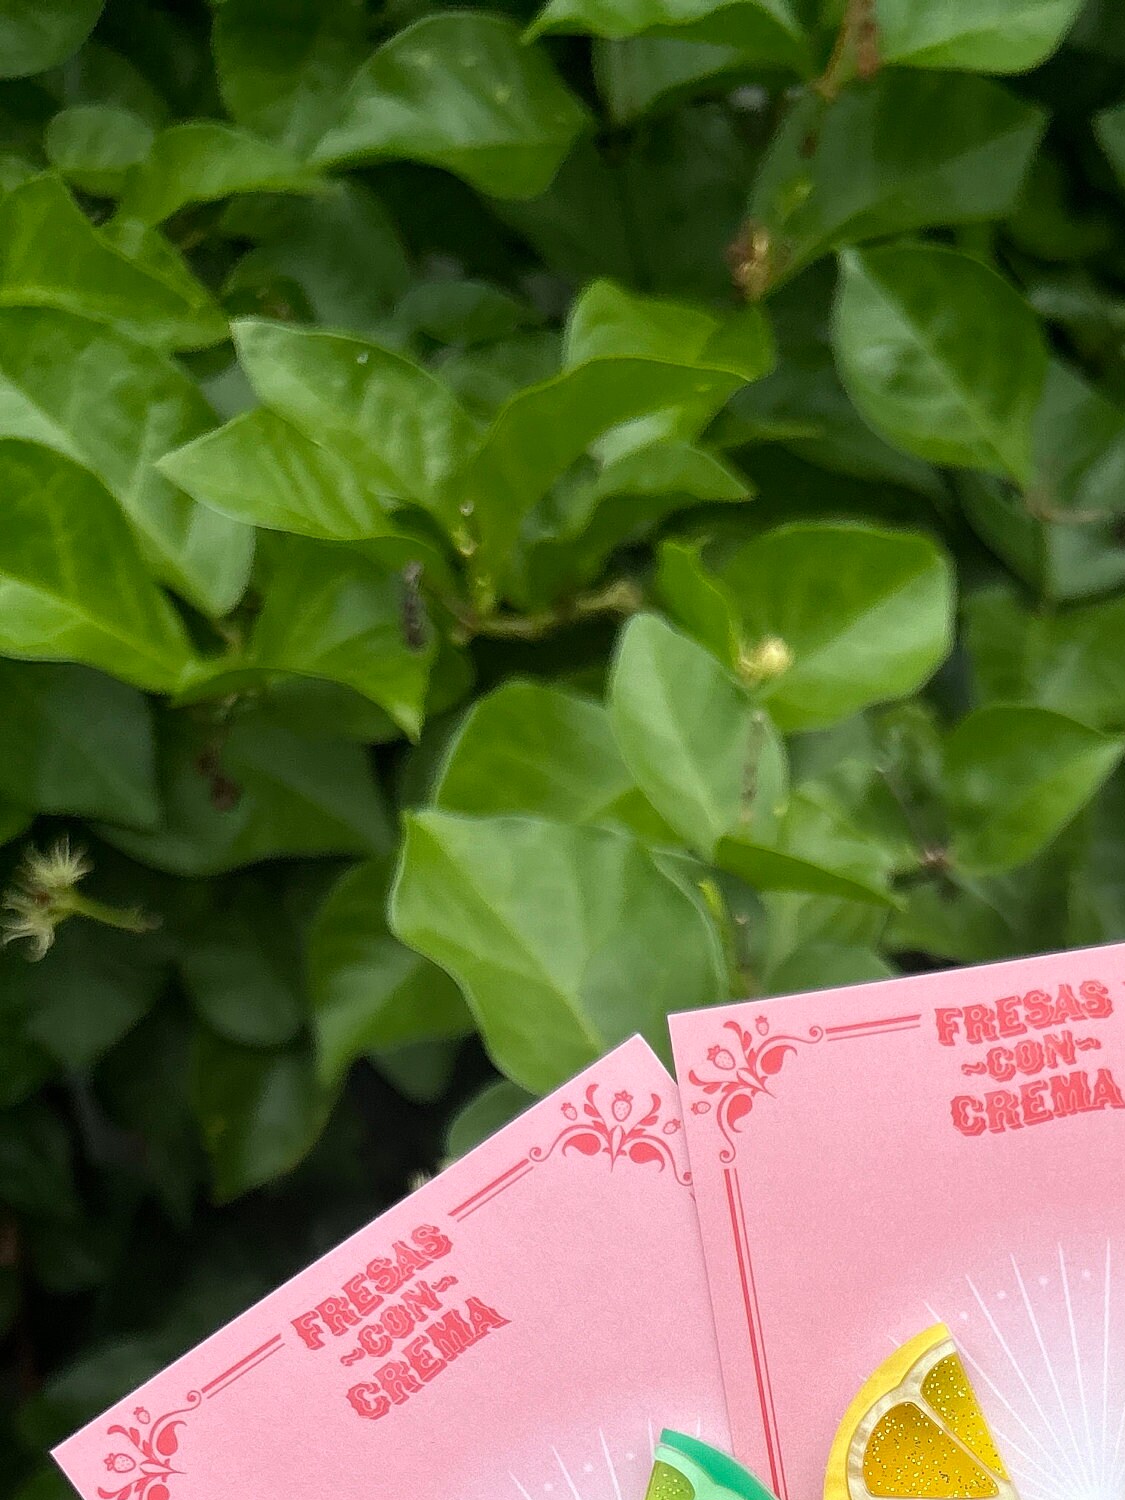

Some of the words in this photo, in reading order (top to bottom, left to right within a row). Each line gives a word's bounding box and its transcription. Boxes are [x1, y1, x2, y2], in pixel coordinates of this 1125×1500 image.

[934, 980, 1113, 1046] FRESAS
[290, 1224, 453, 1350] FRESAS
[346, 1297, 512, 1420] CREMA
